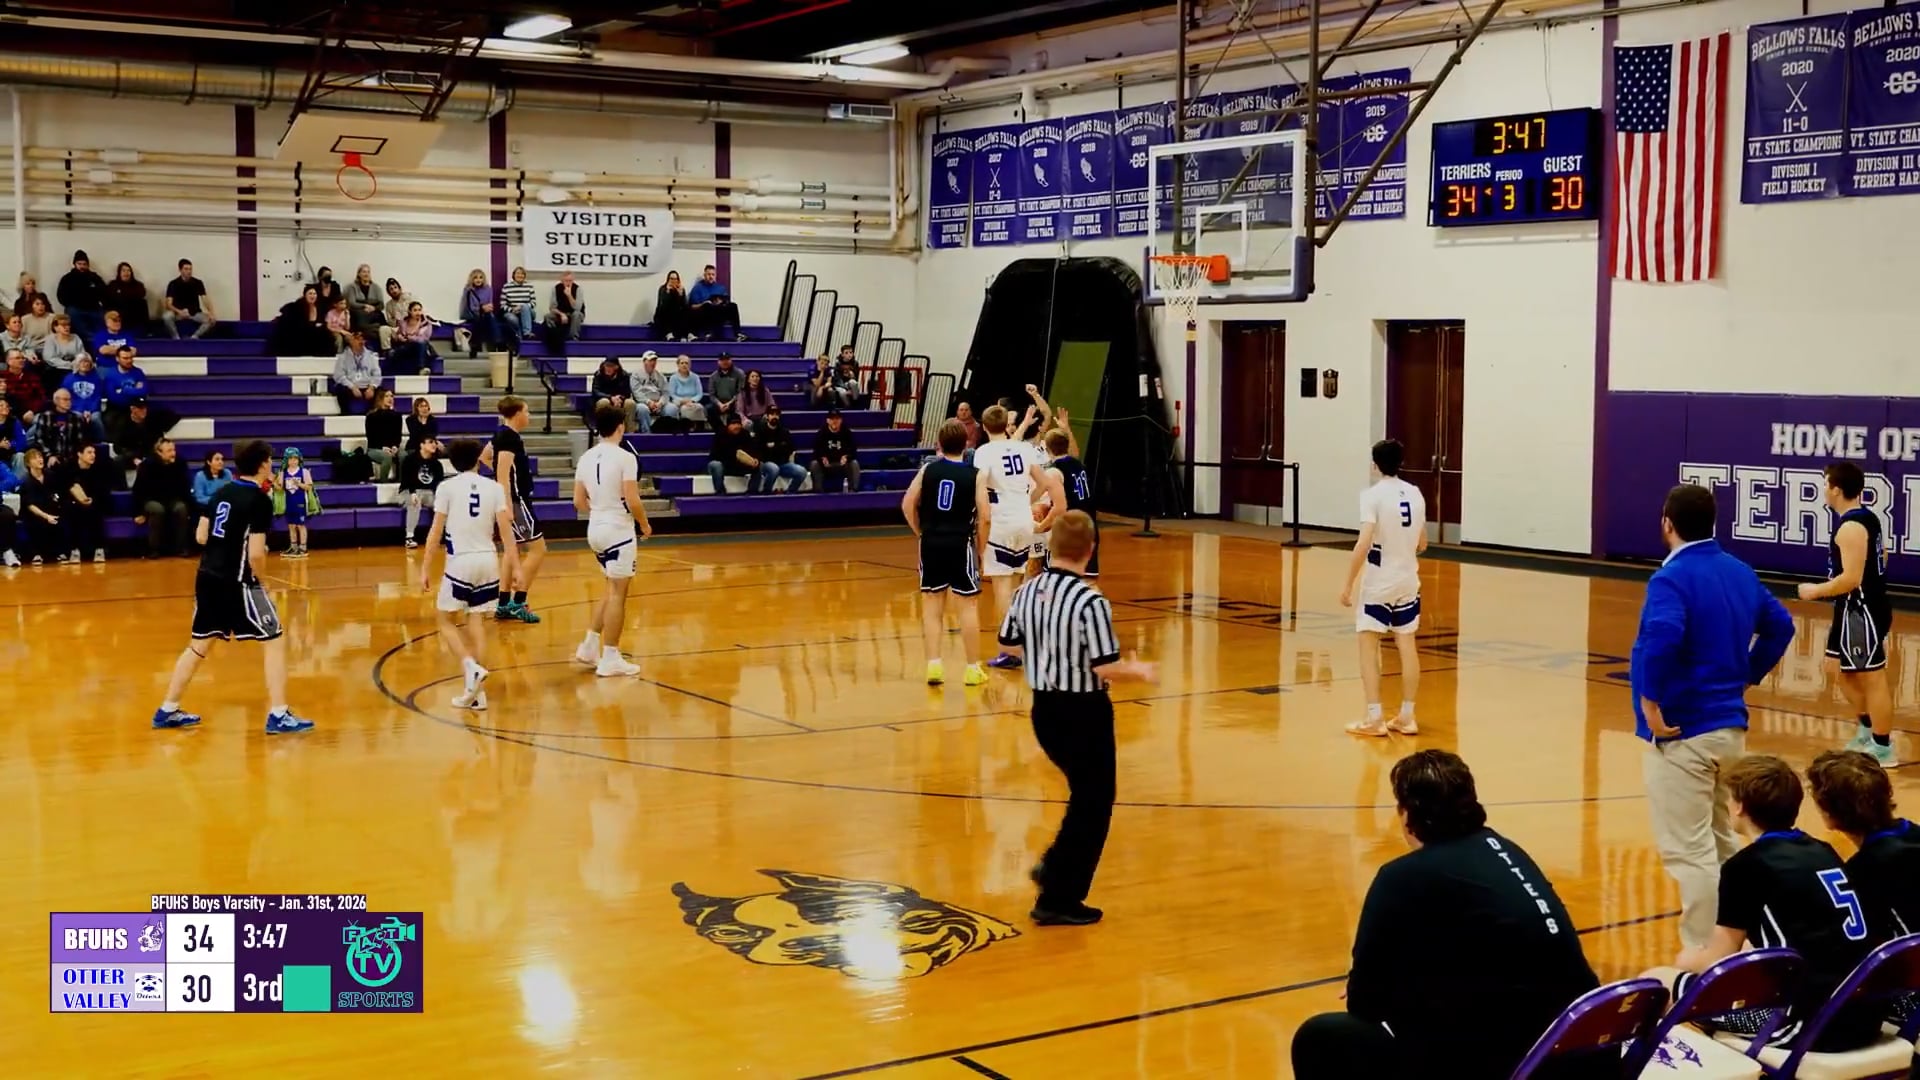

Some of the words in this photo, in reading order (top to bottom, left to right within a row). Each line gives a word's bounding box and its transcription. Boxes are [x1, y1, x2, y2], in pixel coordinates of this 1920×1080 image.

[1852, 12, 1913, 48] BELLOWS
[1751, 27, 1805, 62] BELLOWS
[1807, 26, 1846, 49] FALLS
[1885, 45, 1920, 63] 2020
[1781, 60, 1814, 77] 2020
[1365, 104, 1387, 118] 2019
[1783, 116, 1808, 133] 11-0
[1493, 118, 1546, 154] 3:47
[1748, 142, 1763, 157] VT.
[1764, 140, 1791, 156] STATE
[1793, 135, 1843, 153] CHAMPIONS
[1849, 132, 1866, 148] VT.
[1868, 130, 1897, 146] STATE
[1899, 128, 1920, 144] CHA
[1440, 162, 1491, 181] TERRIERS
[1543, 155, 1583, 173] GUEST
[1771, 163, 1811, 179] DIVISION
[1856, 156, 1899, 172] DIVISION
[1902, 154, 1914, 169] III
[1495, 169, 1523, 181] PERIOD
[1853, 173, 1896, 189] TERRIER
[1504, 184, 1515, 210] 3
[1552, 177, 1582, 210] 30
[1762, 181, 1789, 196] FIELD
[1790, 178, 1827, 194] HOCKEY
[1448, 185, 1476, 216] 34
[552, 211, 646, 228] VISITOR
[545, 232, 653, 247] STUDENT
[551, 253, 648, 267] SECTION
[1771, 422, 1868, 459] HOME
[1878, 427, 1920, 461] OF
[1002, 454, 1024, 476] 30
[469, 493, 480, 517] 2
[937, 479, 956, 511] 0
[212, 501, 231, 538] 2
[1400, 502, 1412, 527] 3
[1486, 837, 1559, 934] OTTERS
[1815, 867, 1868, 940] 5
